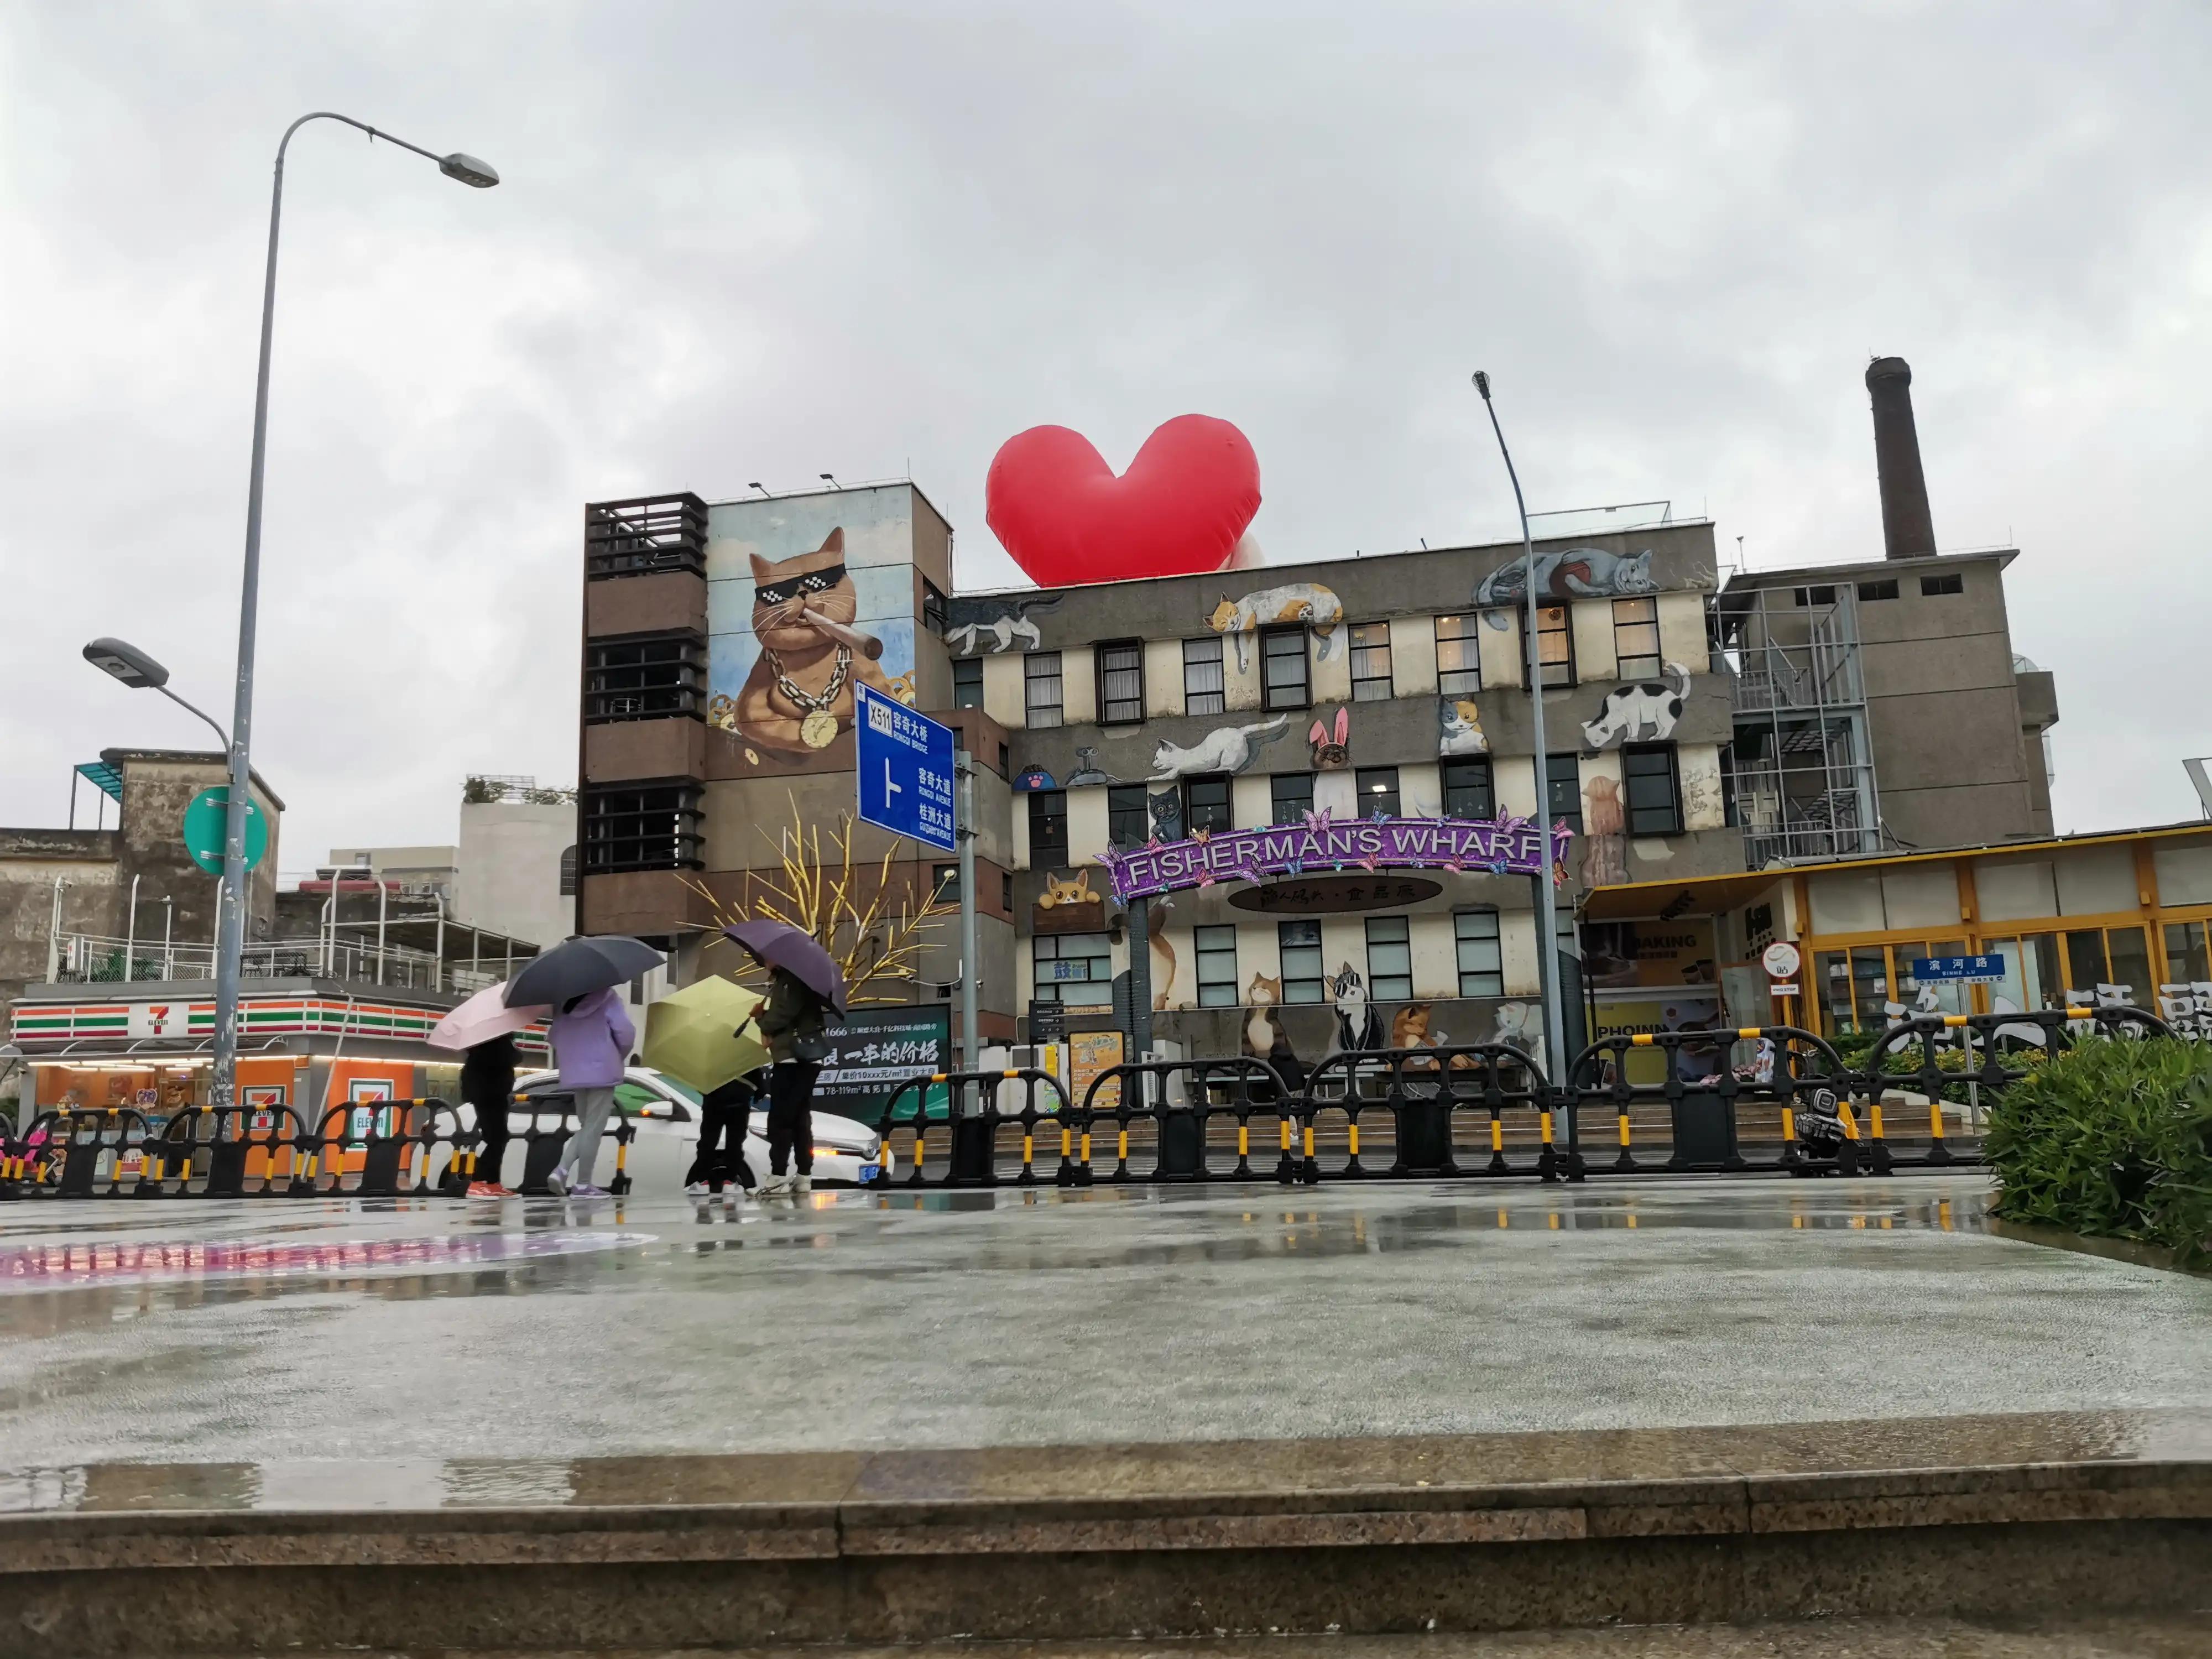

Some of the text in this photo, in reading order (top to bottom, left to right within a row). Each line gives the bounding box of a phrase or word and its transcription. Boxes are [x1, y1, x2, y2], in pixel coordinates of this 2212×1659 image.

[870, 704, 890, 731] X511
[893, 711, 928, 743] 容奇大桥
[919, 767, 951, 796] 容奇大道
[919, 802, 951, 831] 桂洲大道
[1128, 828, 1541, 885] FISHERMAN'S WHARF
[1929, 957, 1987, 971] 滨河路
